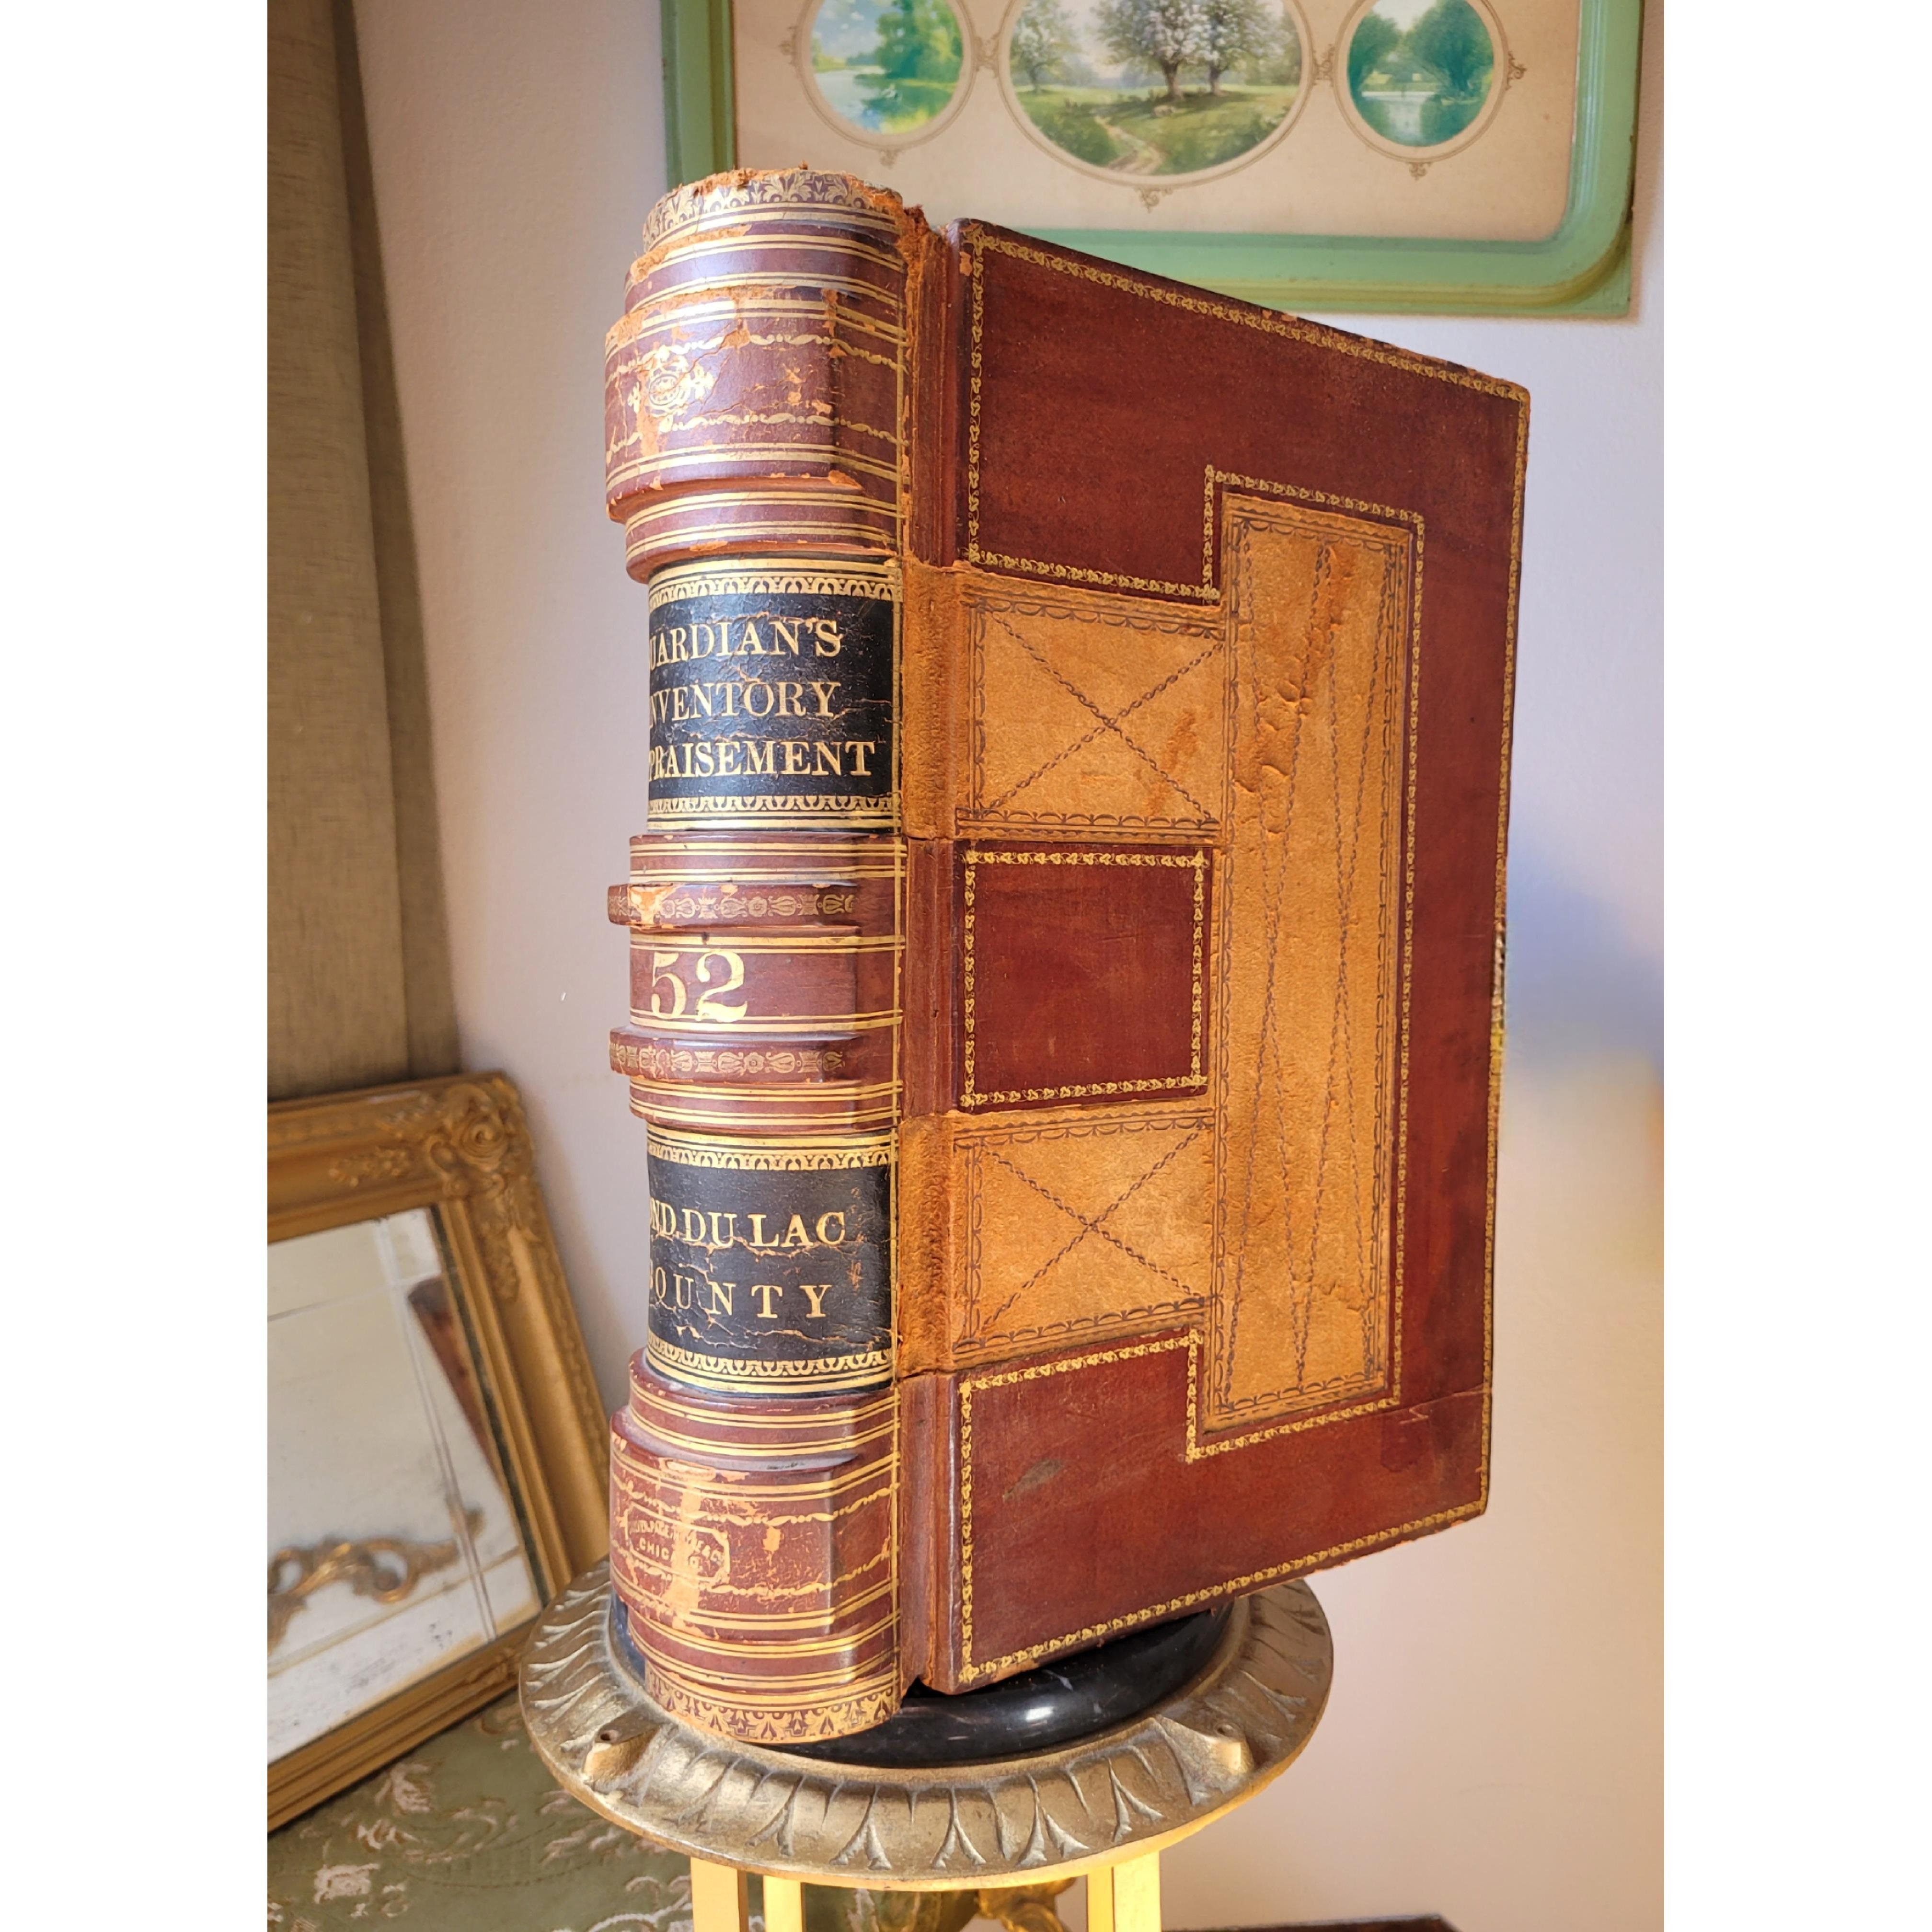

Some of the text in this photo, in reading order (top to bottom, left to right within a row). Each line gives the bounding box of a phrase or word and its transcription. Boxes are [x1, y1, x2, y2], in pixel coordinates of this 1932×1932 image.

[651, 950, 748, 1023] 52
[650, 1197, 846, 1247] ND DU LAC
[649, 1258, 832, 1318] OUNTY
